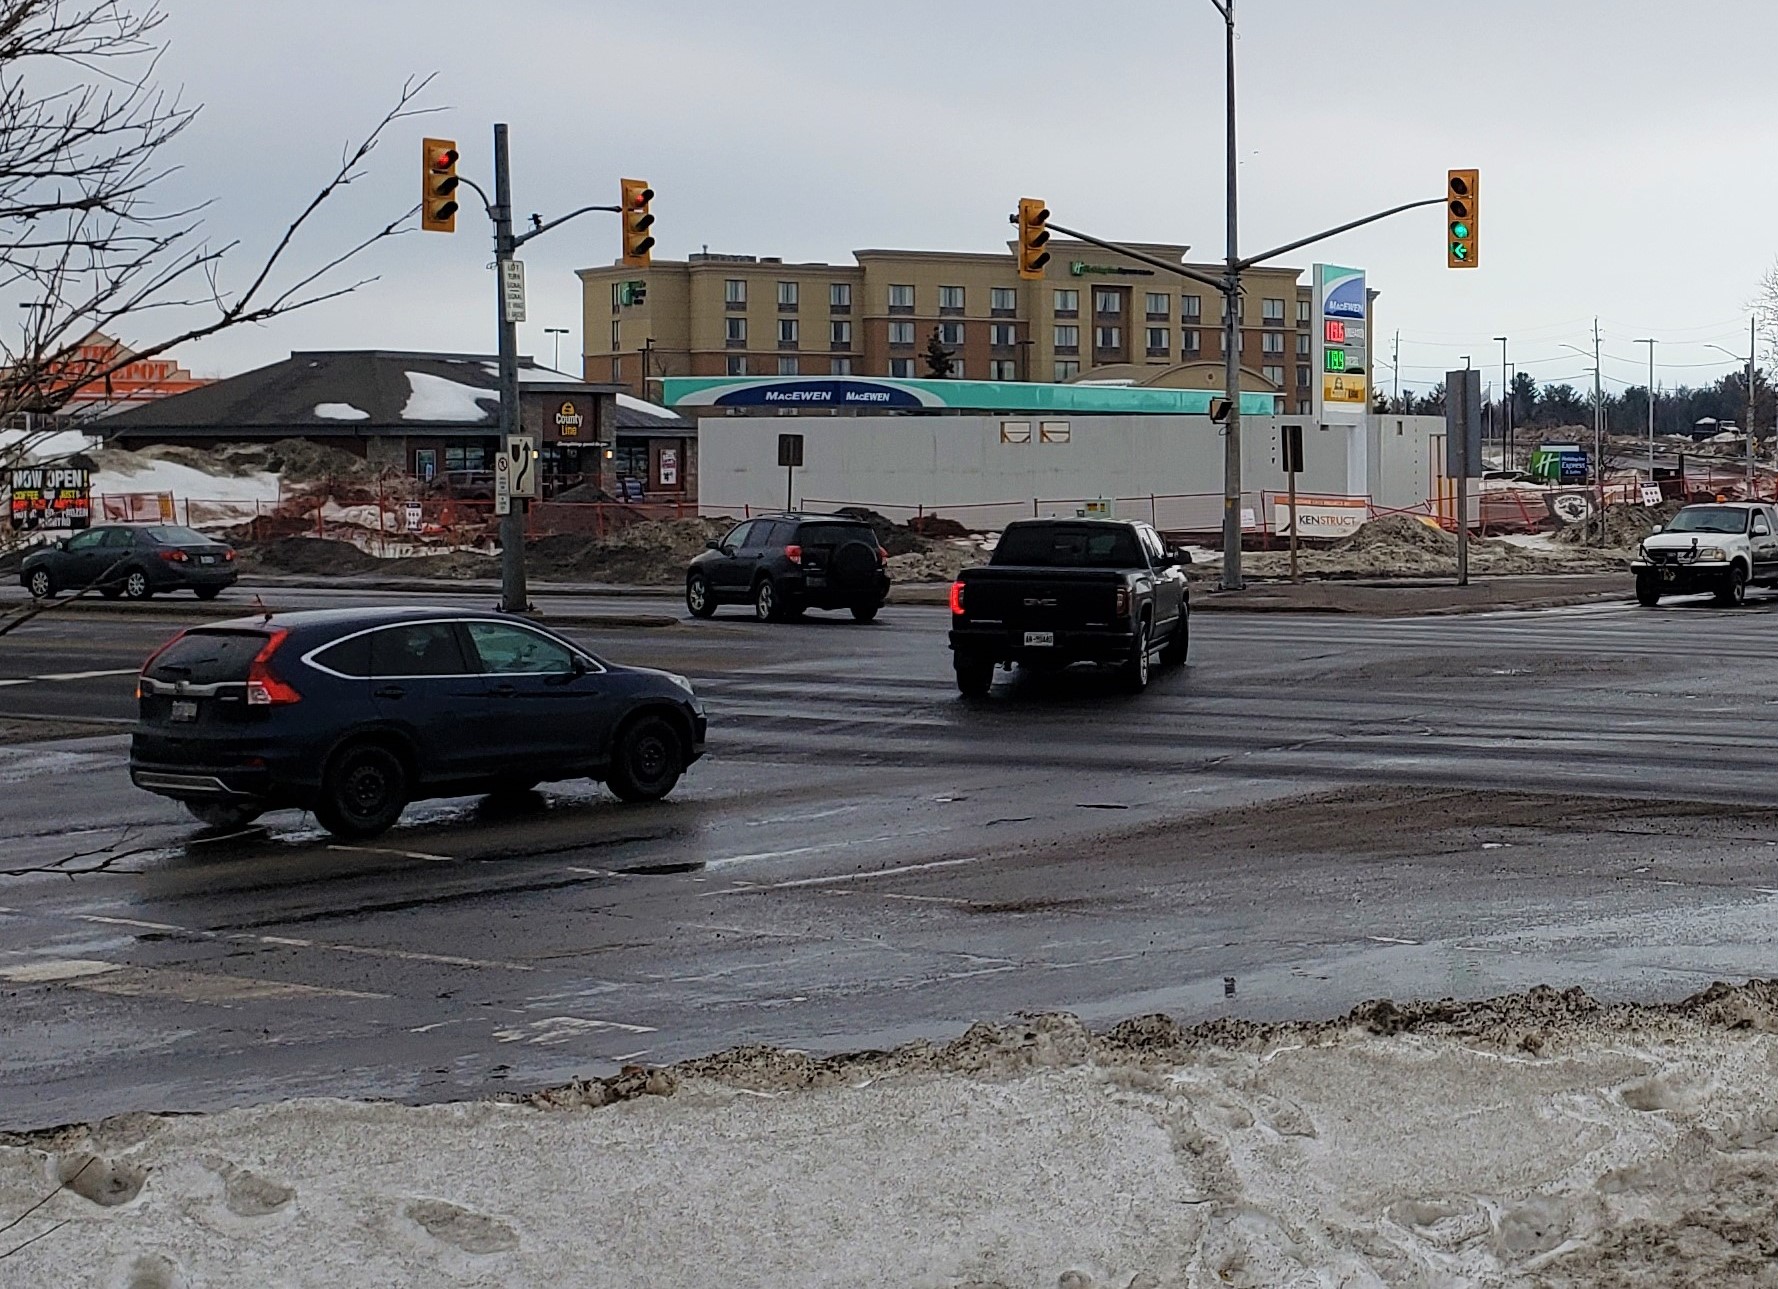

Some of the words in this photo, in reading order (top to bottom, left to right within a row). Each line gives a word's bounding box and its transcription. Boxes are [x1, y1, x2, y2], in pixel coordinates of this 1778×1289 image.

[555, 412, 584, 428] County
[561, 424, 577, 436] Line
[1561, 461, 1586, 470] Express
[12, 470, 42, 488] NOW
[47, 469, 88, 487] OPEN!
[1299, 514, 1357, 527] KENSTRUCT
